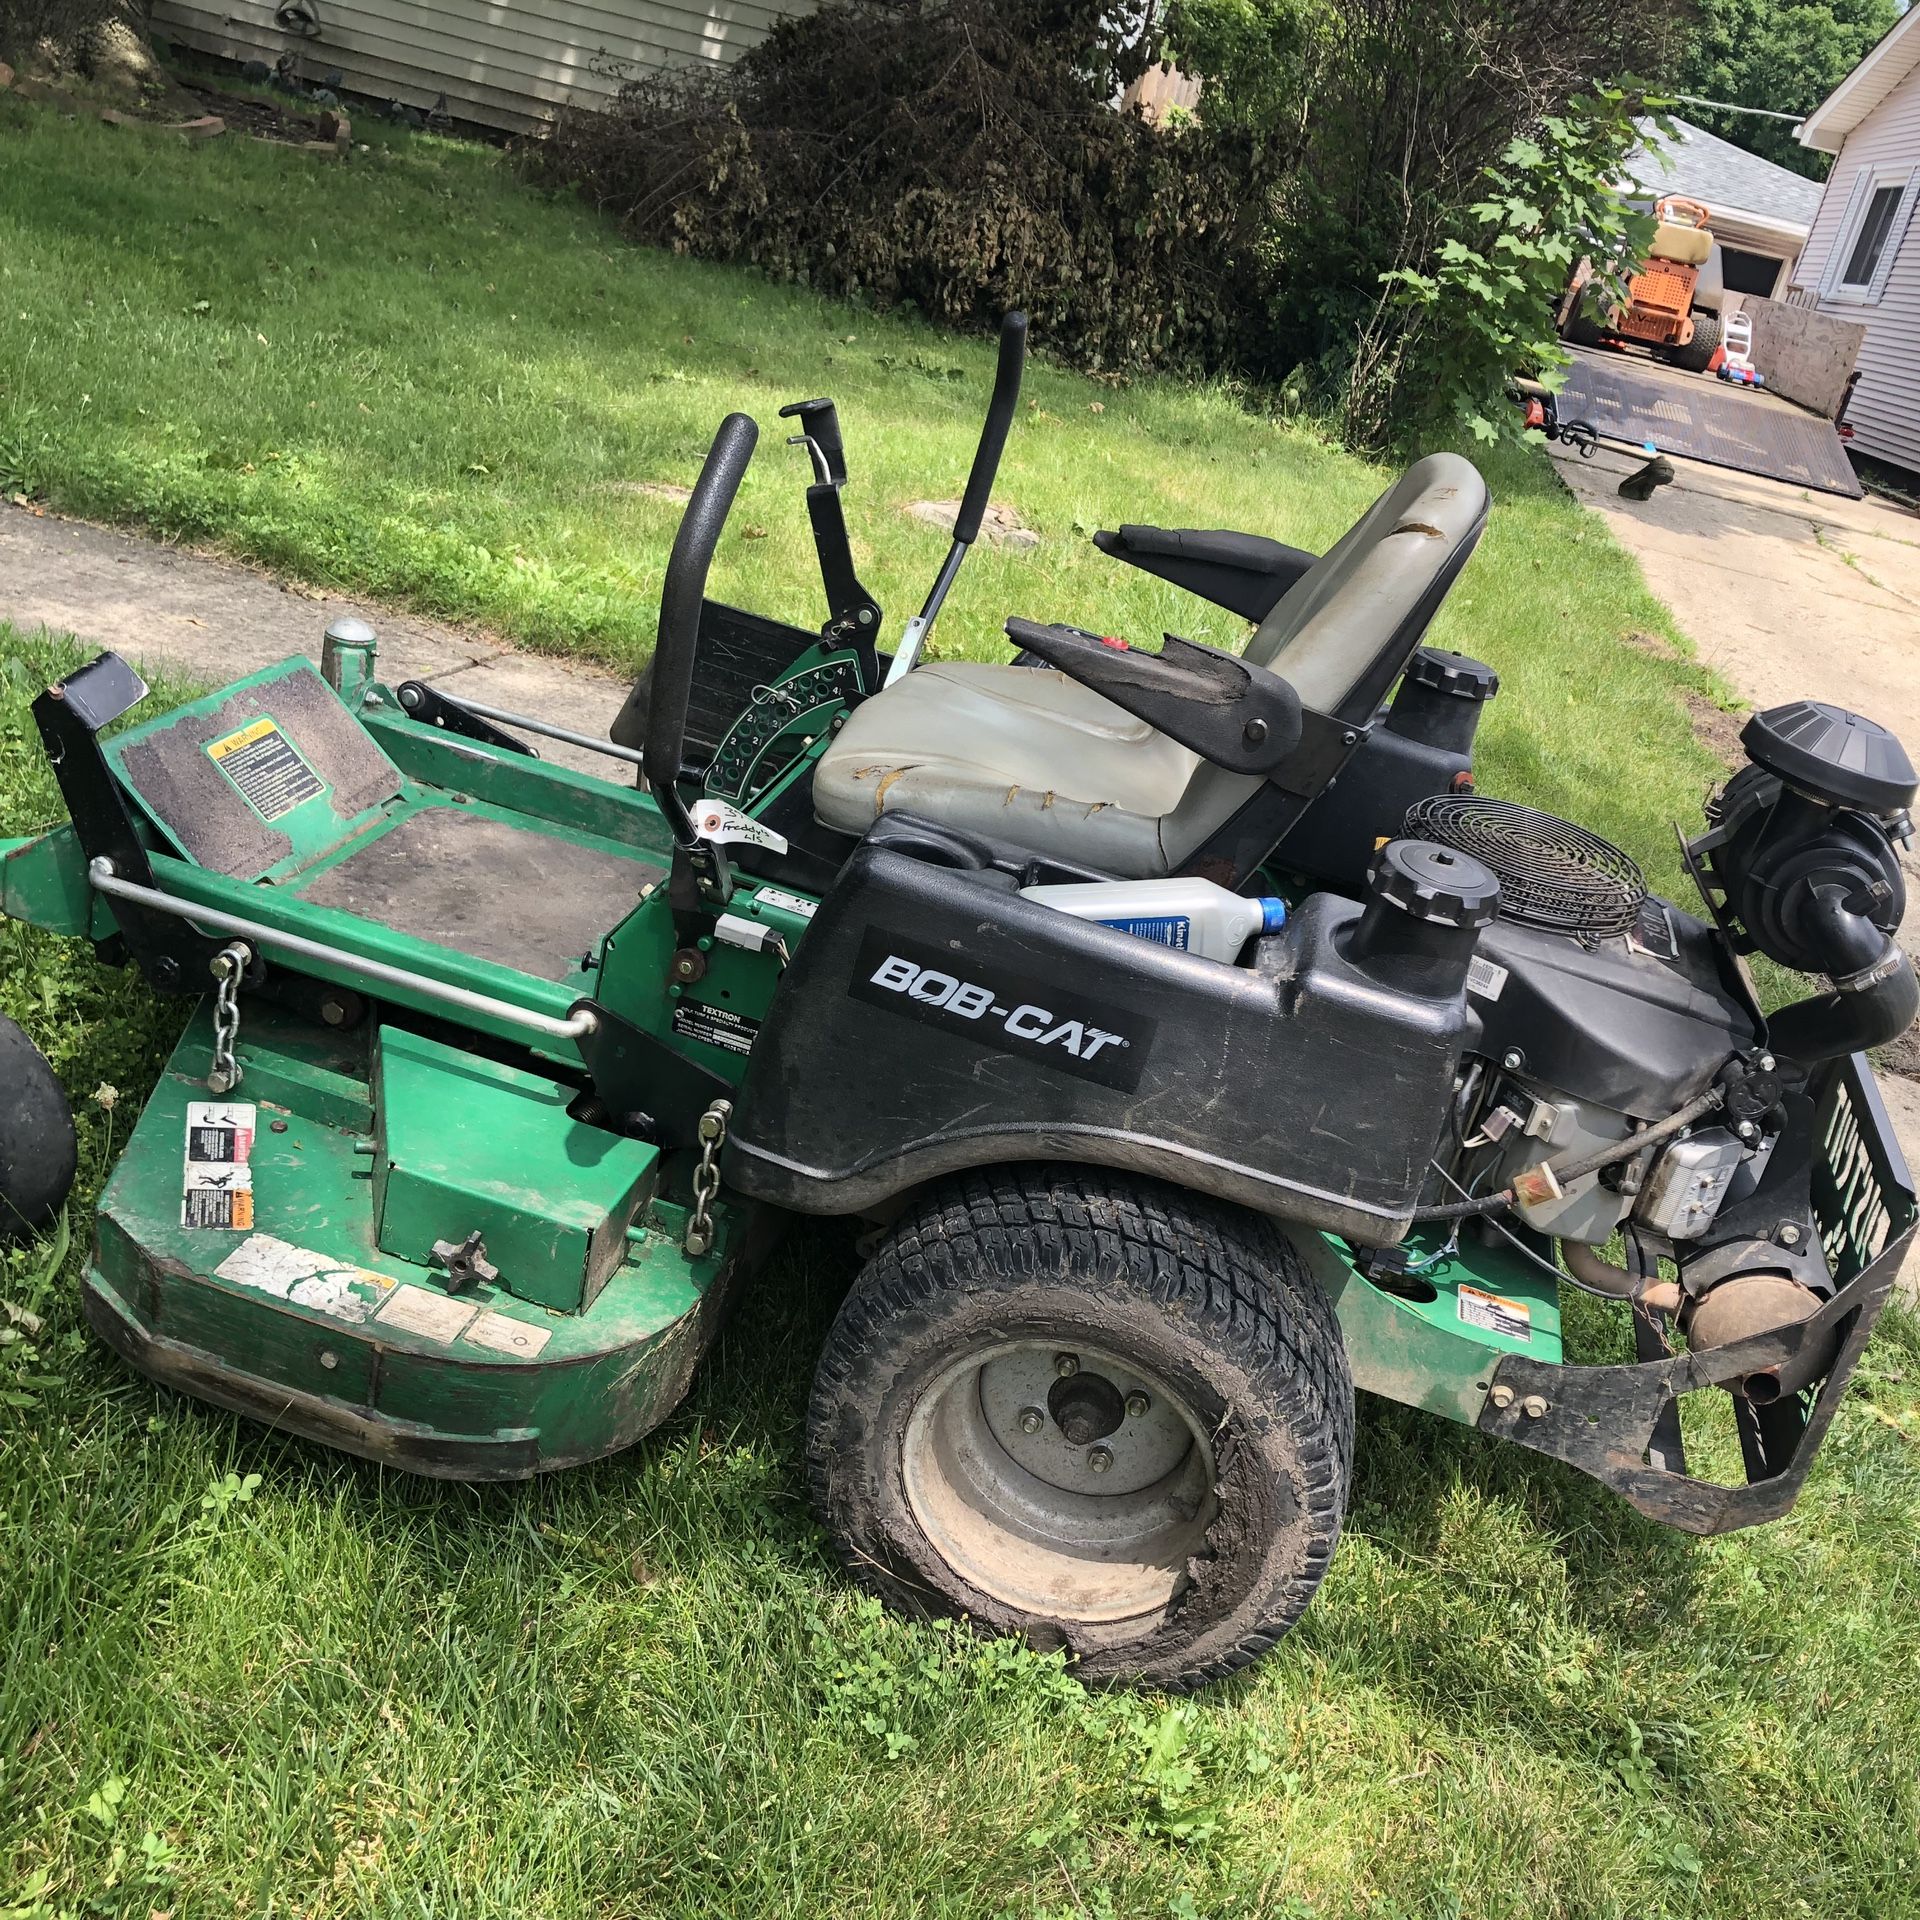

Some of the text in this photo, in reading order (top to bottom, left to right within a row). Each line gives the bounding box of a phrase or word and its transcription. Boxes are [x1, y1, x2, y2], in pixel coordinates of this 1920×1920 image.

[702, 1005, 741, 1023] TEXTRON
[870, 955, 1124, 1061] BOB-CAT
[236, 1198, 245, 1227] WARNING
